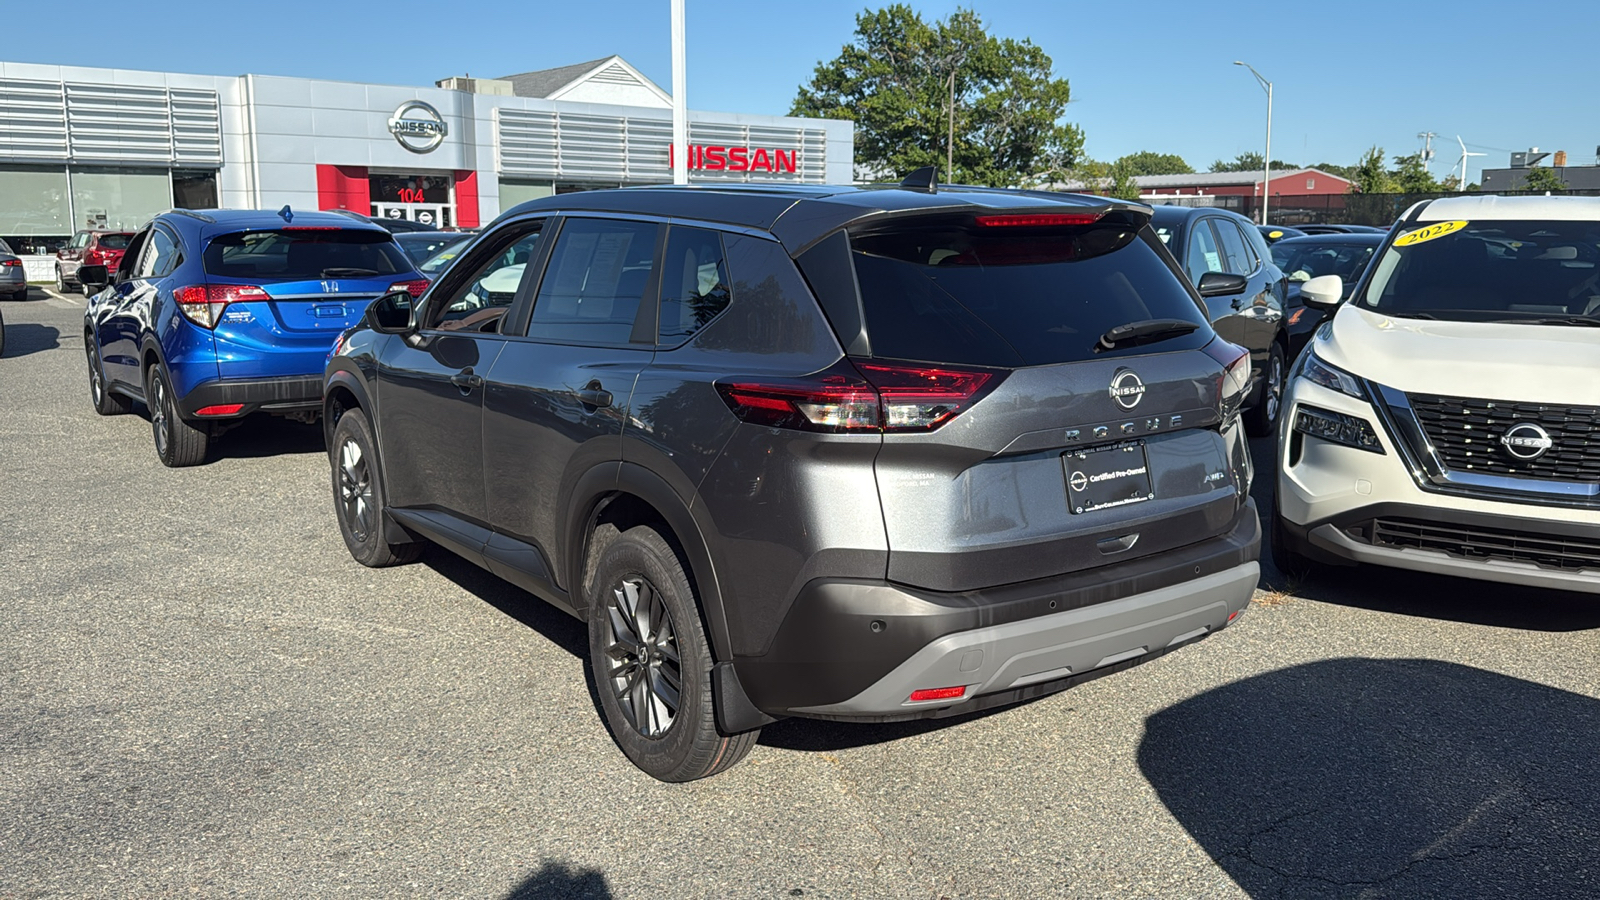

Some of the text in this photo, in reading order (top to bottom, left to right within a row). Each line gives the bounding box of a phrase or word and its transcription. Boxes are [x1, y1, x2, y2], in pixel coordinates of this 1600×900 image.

[395, 121, 443, 133] NISSAN
[397, 188, 425, 203] 104
[1408, 222, 1455, 243] 2022
[1112, 385, 1146, 396] NISSAN
[1065, 415, 1182, 442] ROGUE
[1089, 466, 1146, 483] Certified Pre-Owned
